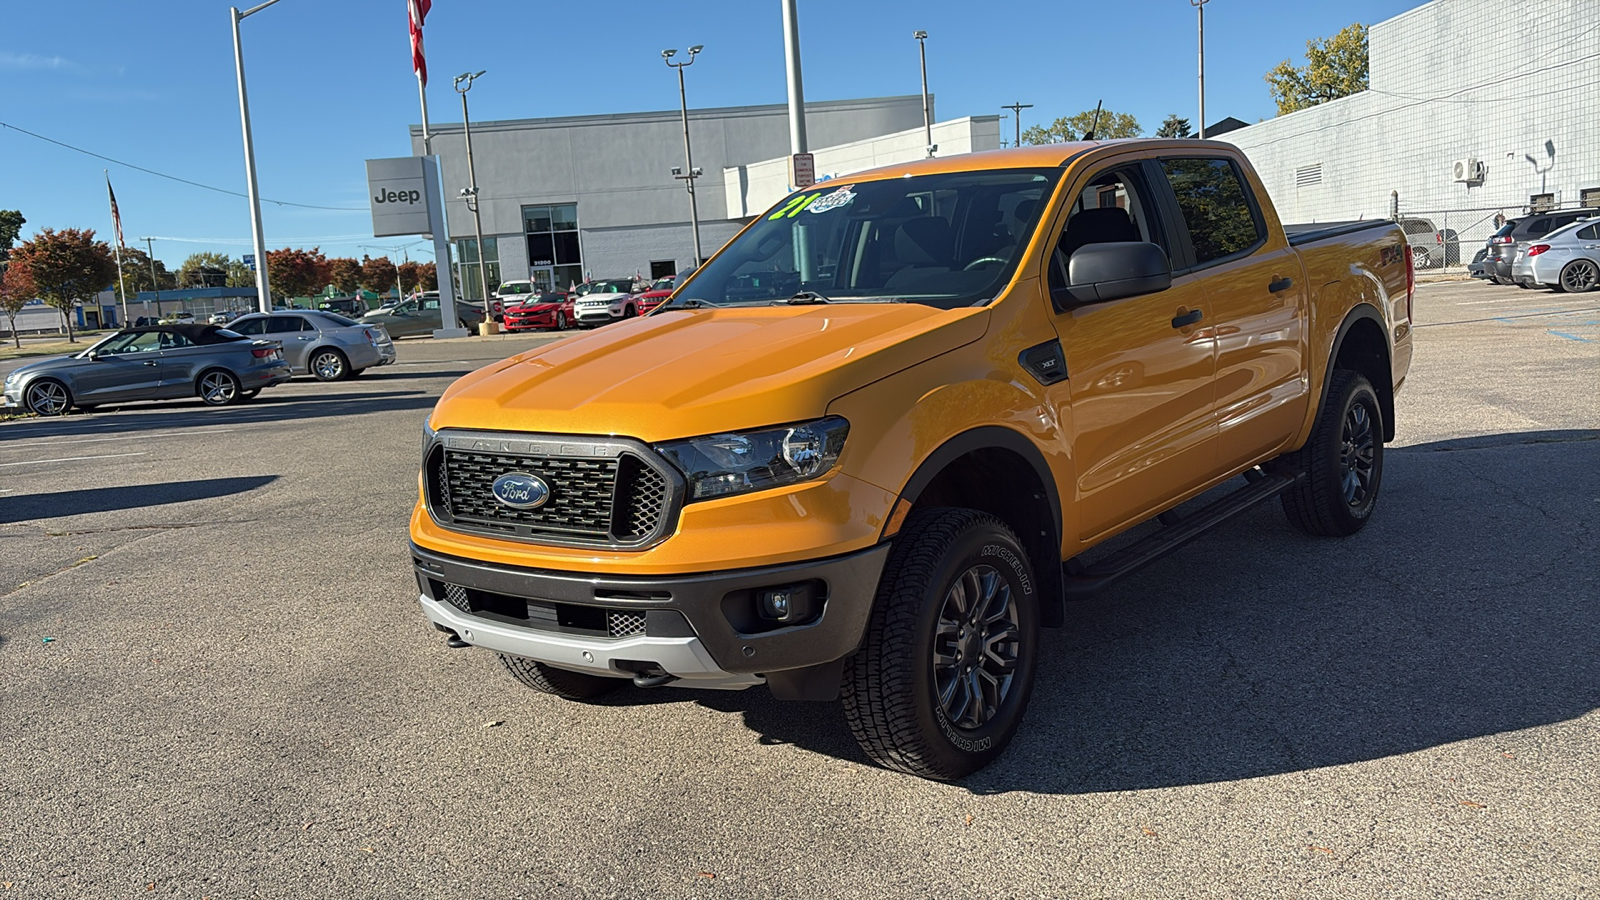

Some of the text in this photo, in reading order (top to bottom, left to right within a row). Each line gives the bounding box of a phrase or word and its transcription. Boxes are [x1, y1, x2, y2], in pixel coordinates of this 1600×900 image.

[374, 188, 421, 205] Jeep
[768, 192, 821, 220] 21
[1041, 358, 1056, 369] XLT
[448, 438, 609, 456] RANGER
[501, 480, 531, 501] Ford
[980, 545, 1033, 595] MICHELIN
[935, 705, 992, 752] MICHELIN
